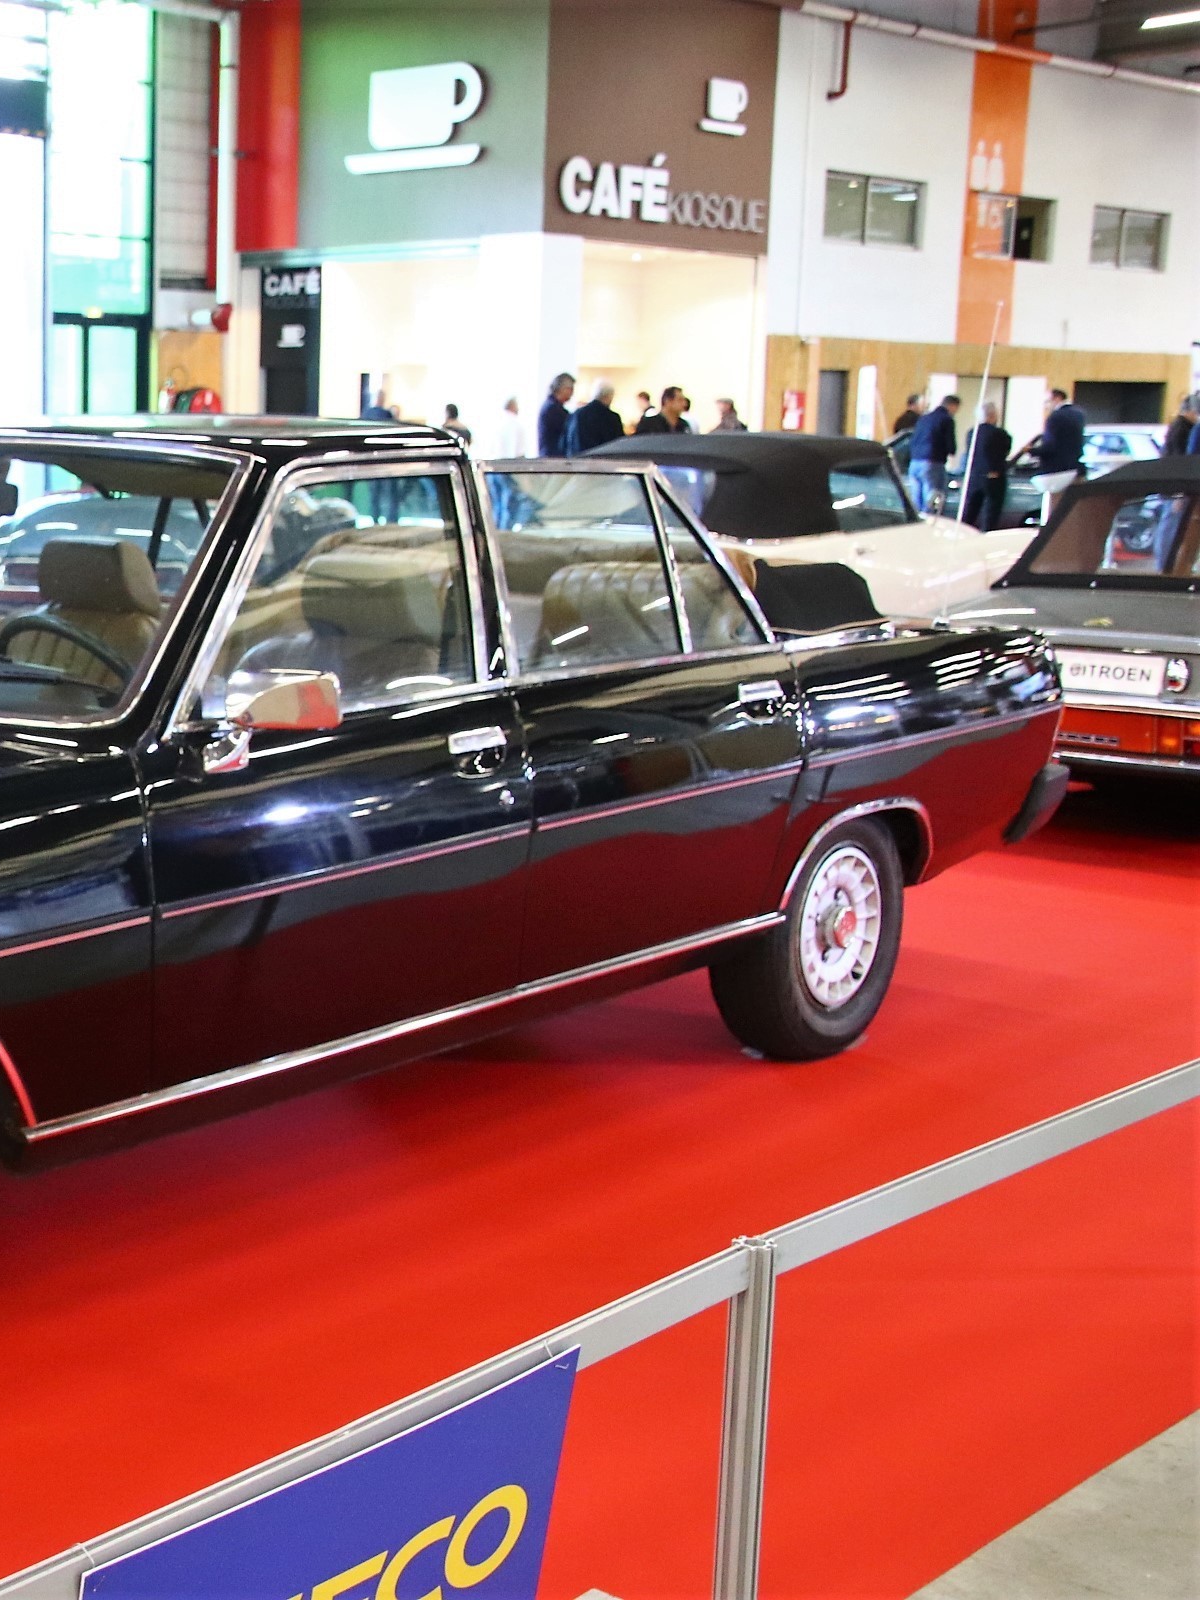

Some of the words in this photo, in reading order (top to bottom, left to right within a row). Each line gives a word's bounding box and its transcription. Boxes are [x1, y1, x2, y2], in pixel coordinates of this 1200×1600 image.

[560, 152, 670, 222] CAFÉ
[668, 191, 767, 233] KIOSQUE
[264, 268, 320, 296] CAFÉ
[286, 1484, 528, 1600] CO
